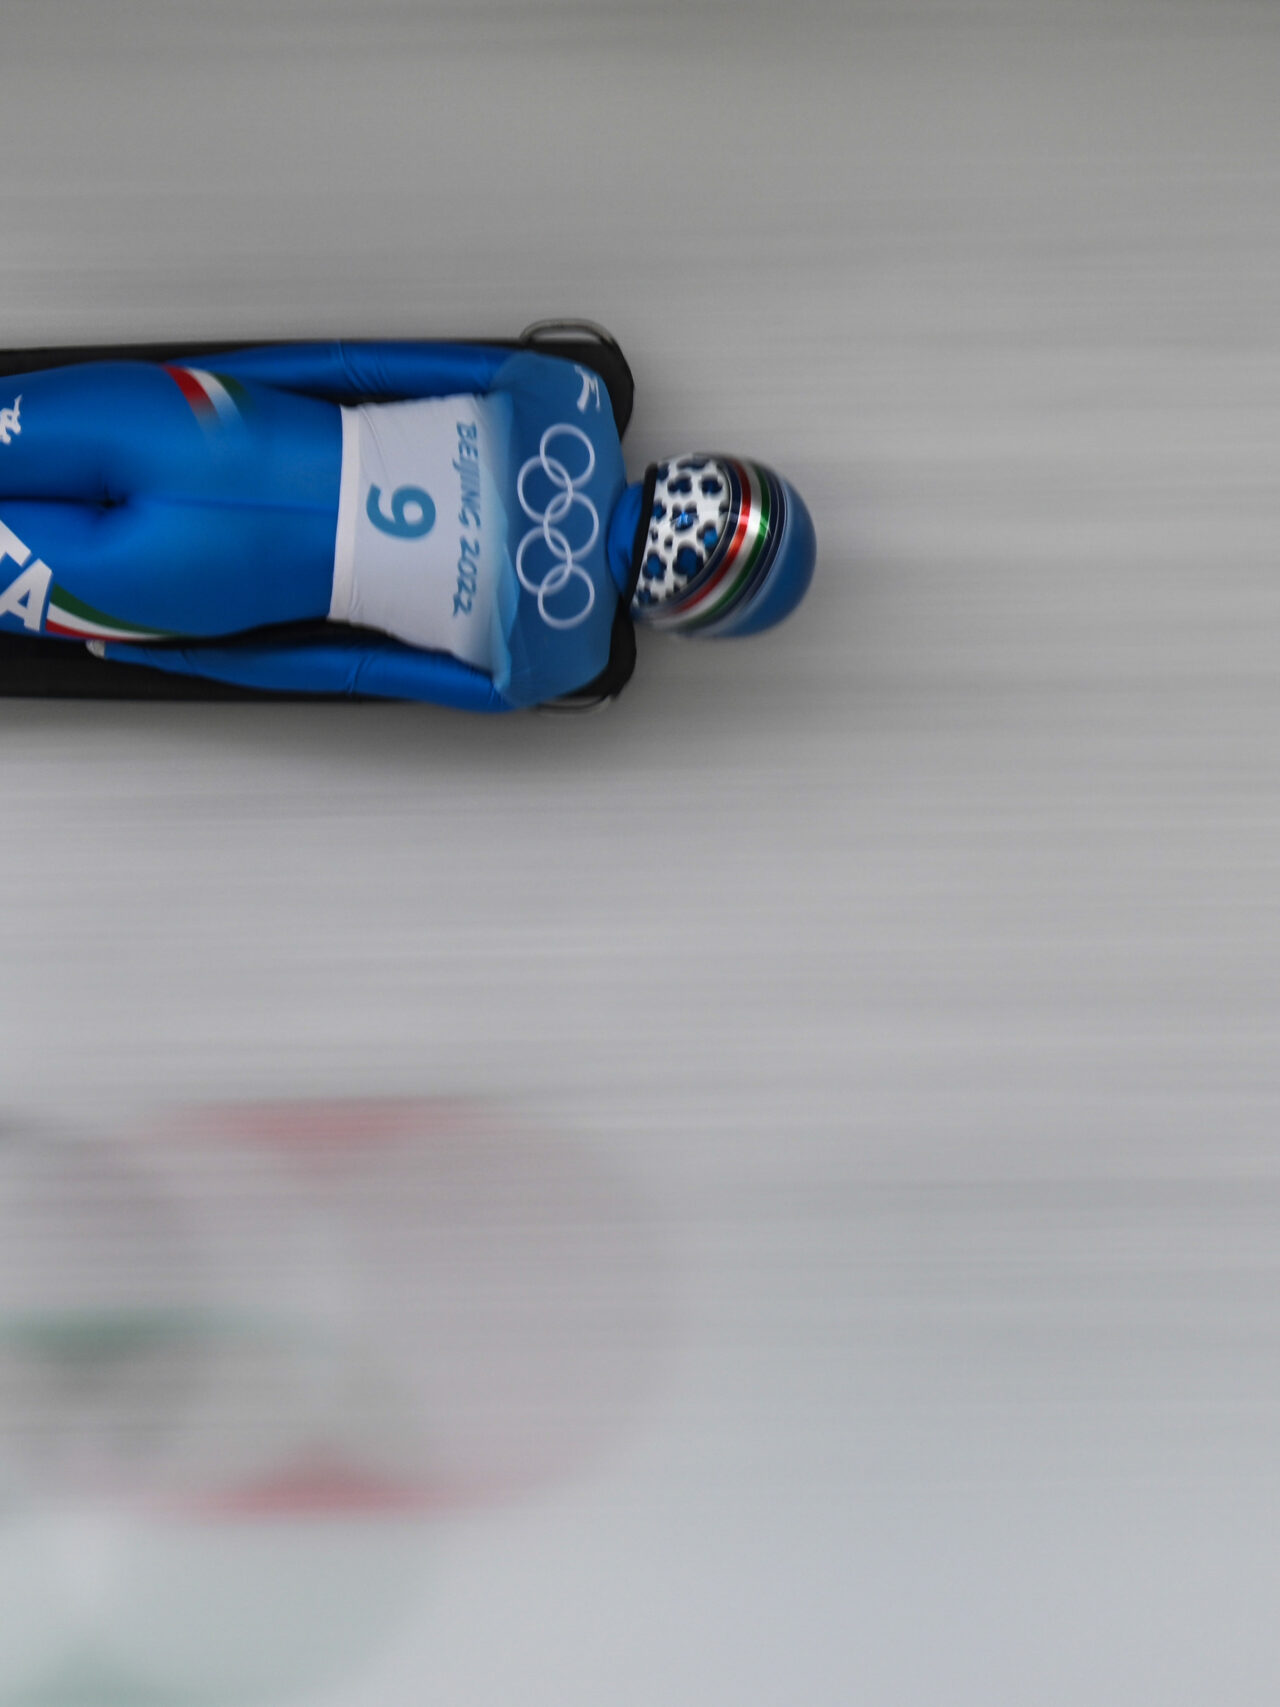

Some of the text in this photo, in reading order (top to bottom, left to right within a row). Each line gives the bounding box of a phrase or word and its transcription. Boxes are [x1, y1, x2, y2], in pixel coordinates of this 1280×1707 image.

[366, 483, 436, 541] 9
[452, 420, 482, 618] BEIJING 2022
